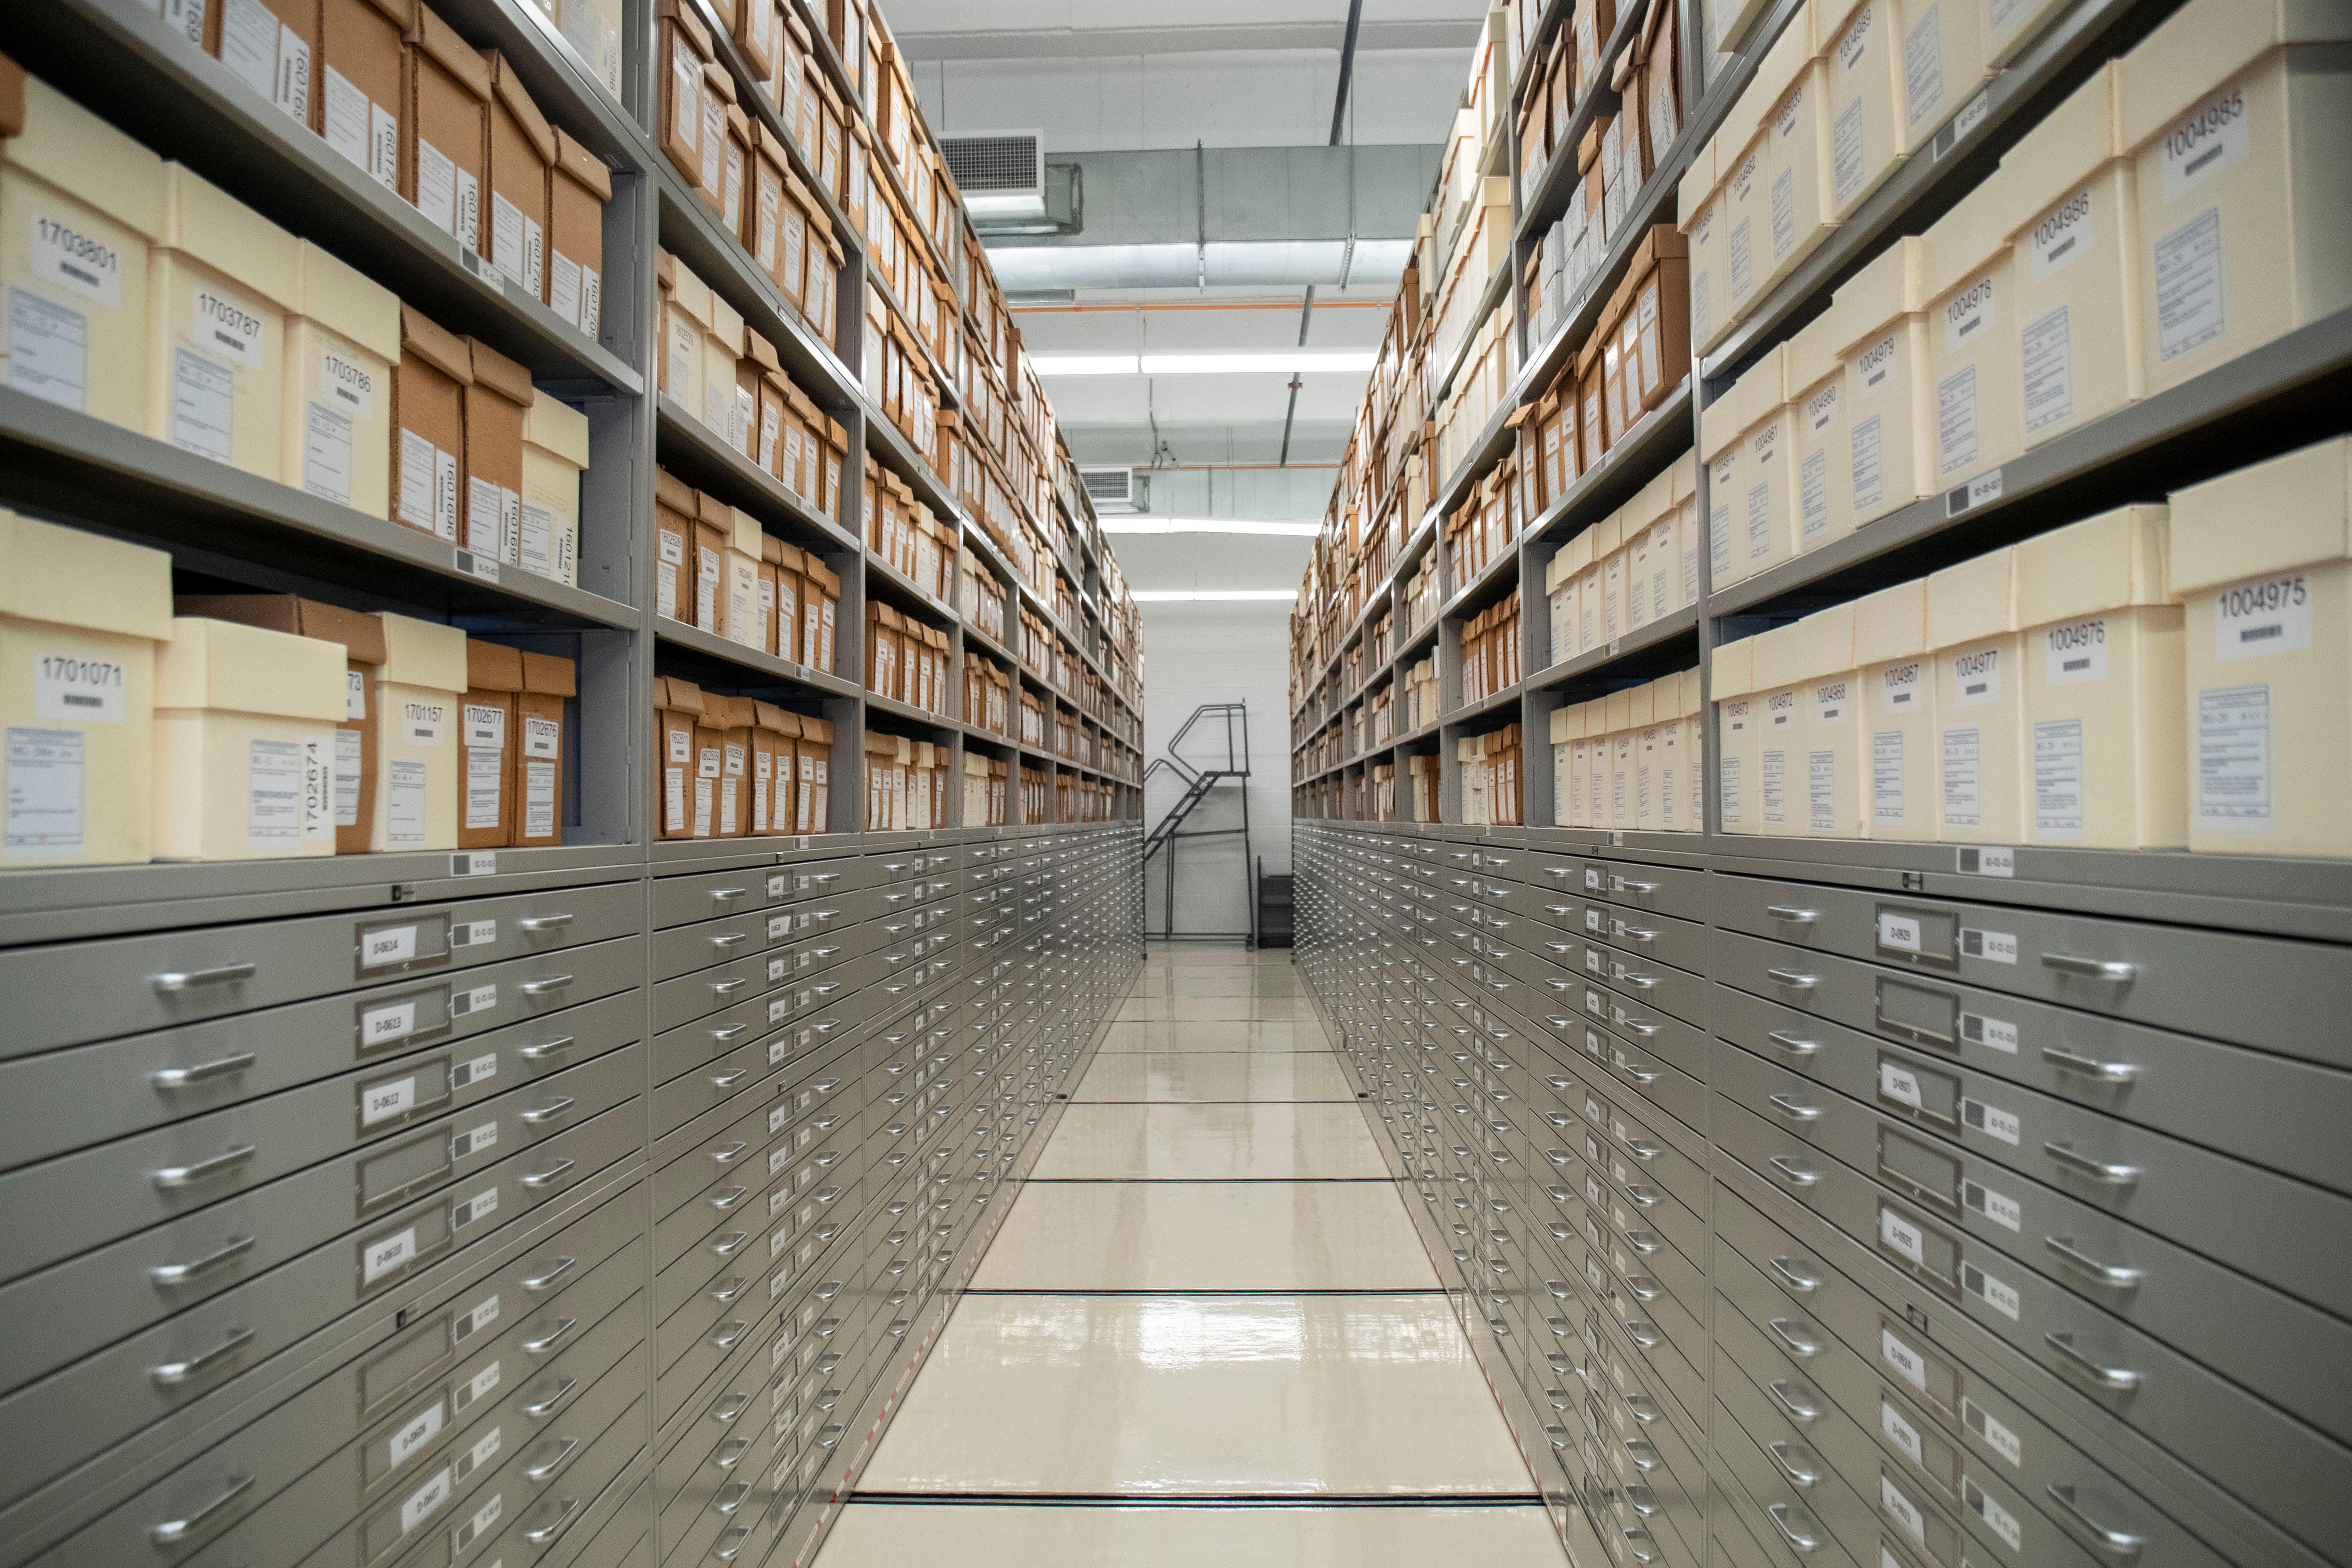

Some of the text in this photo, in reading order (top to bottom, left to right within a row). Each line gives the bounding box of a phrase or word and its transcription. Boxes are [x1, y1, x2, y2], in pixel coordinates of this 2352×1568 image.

[293, 49, 309, 125] 160169
[705, 94, 722, 122] 602542
[2166, 91, 2242, 162] 1004985
[385, 122, 396, 192] 160170
[468, 183, 477, 247] 160170
[200, 293, 261, 339] 1703787
[589, 278, 599, 340] 1601705
[1947, 279, 1992, 324] 1004978
[325, 355, 372, 393] 1703786
[1808, 385, 1836, 418] 1004980
[1755, 424, 1778, 453] 1004981
[446, 461, 455, 537] 1601696
[509, 498, 520, 567] 1601695
[2220, 576, 2306, 619] 1004975
[43, 657, 122, 687] 1701071
[1884, 664, 1919, 688] 1004967
[1956, 651, 1997, 677] 1004977
[405, 703, 443, 723] 1701157
[466, 707, 503, 726] 1702677
[1768, 692, 1793, 711] 1004972
[527, 720, 558, 738] 1702676
[306, 741, 318, 835] 1702674
